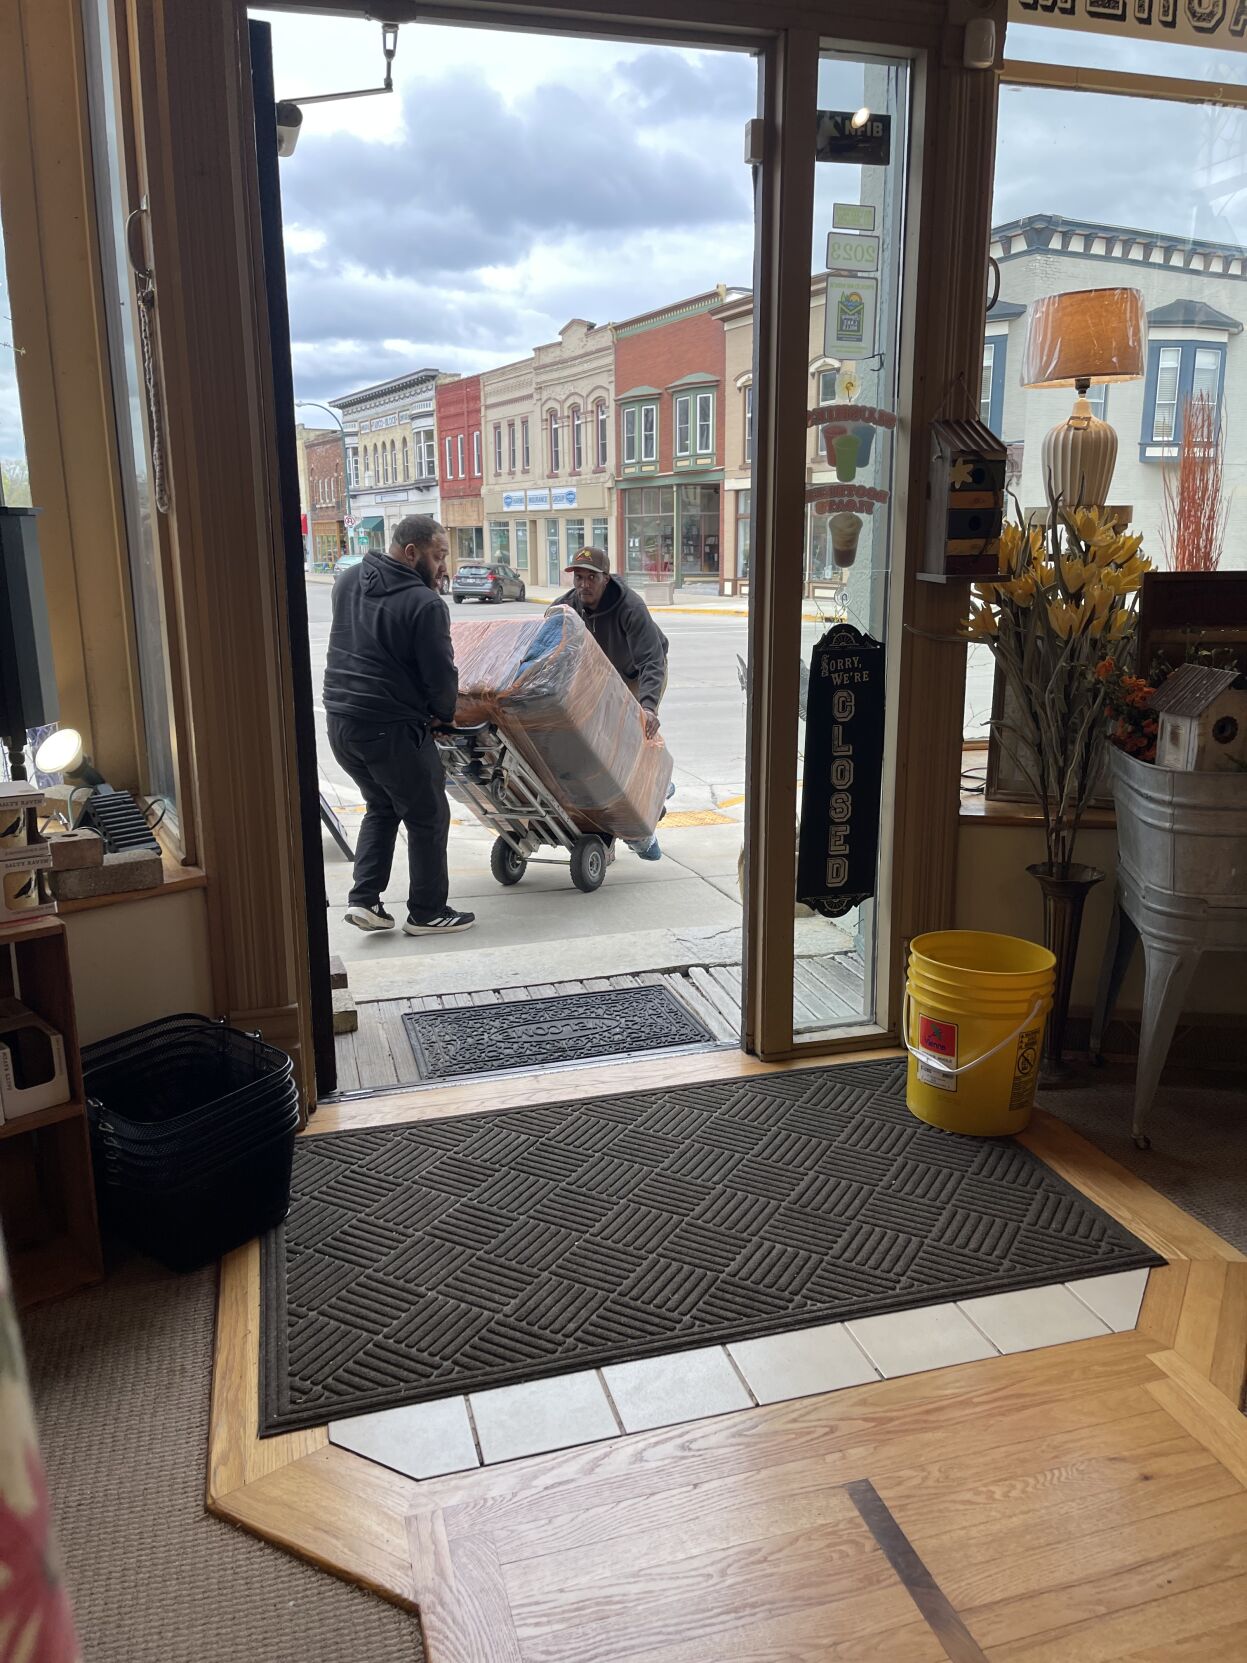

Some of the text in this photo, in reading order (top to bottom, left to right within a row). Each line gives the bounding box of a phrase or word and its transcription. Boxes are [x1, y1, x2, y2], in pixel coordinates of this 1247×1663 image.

[830, 671, 869, 686] WE'RE
[825, 689, 856, 888] CLOSED
[501, 1020, 613, 1041] WELCOME
